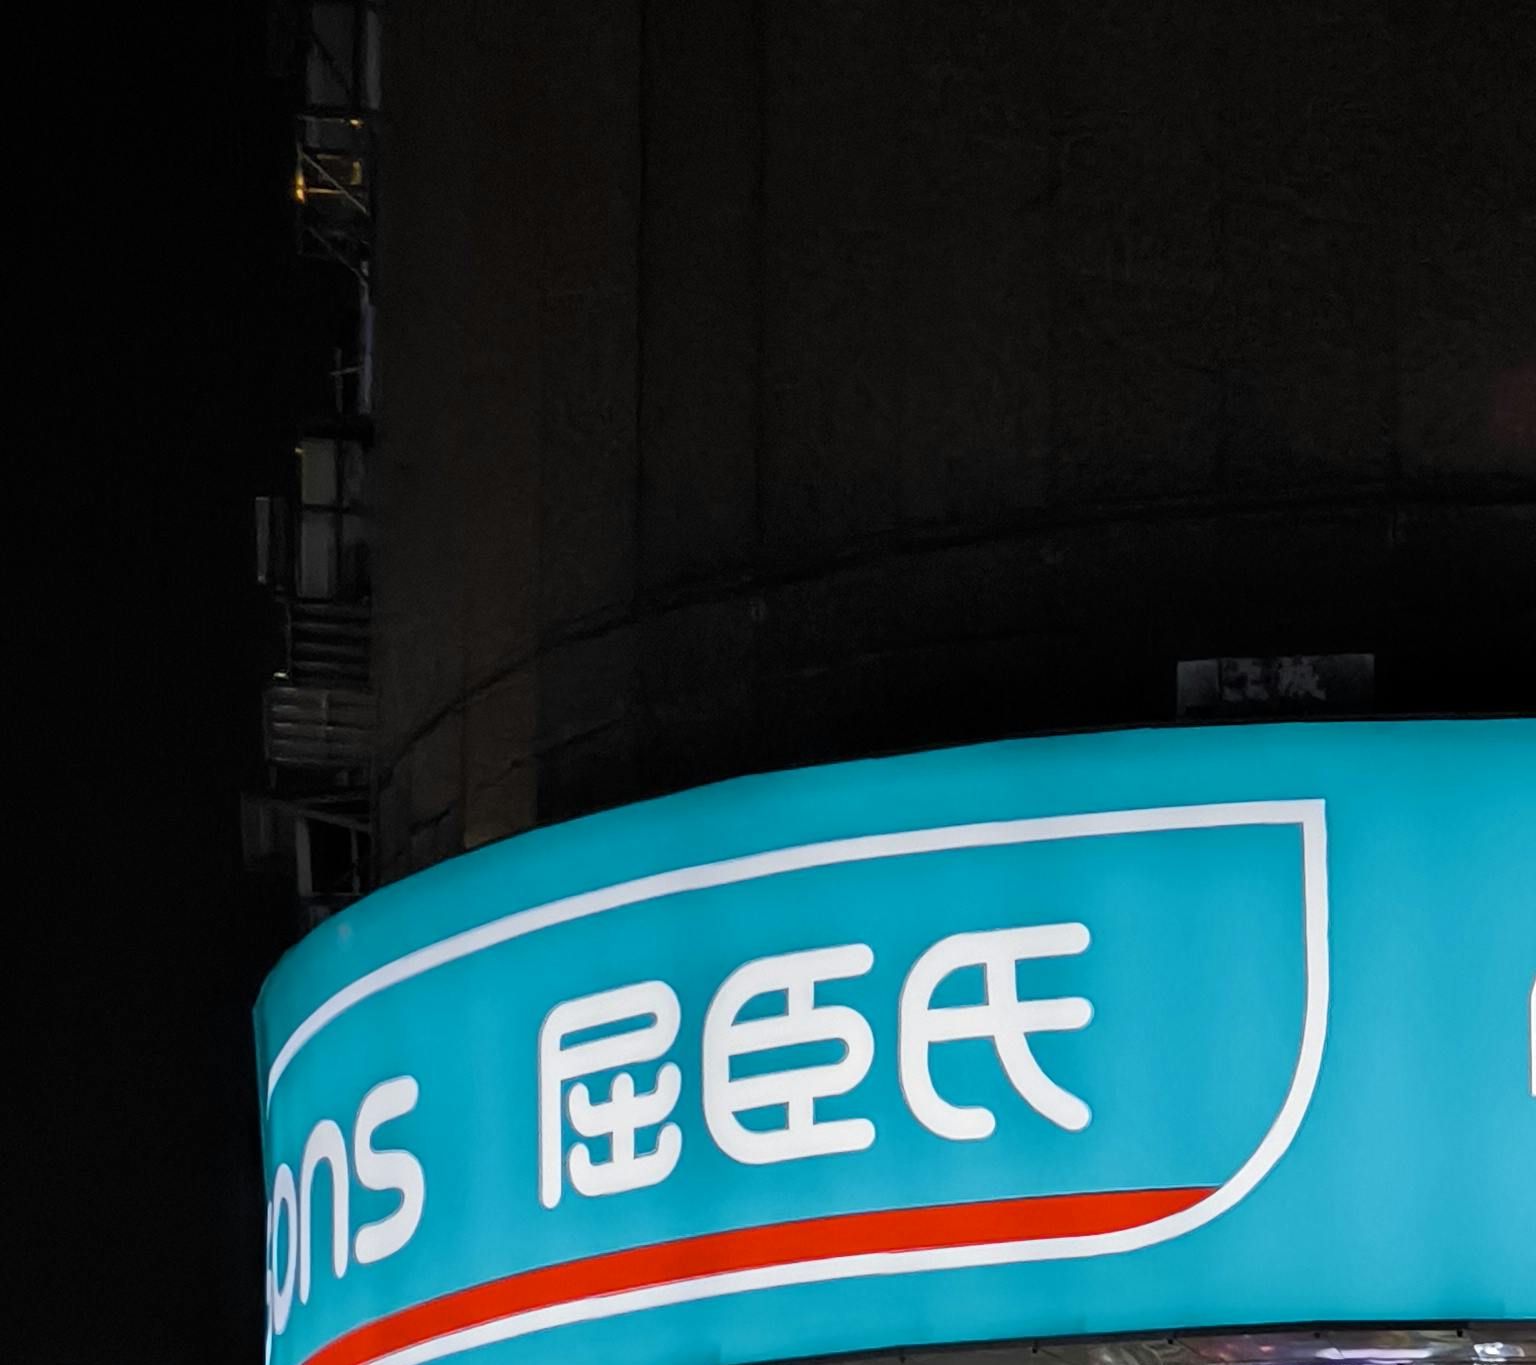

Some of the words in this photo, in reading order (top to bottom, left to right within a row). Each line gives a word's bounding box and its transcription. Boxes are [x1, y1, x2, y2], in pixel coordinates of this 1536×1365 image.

[538, 921, 1093, 1210] 屈臣氏
[266, 1074, 426, 1336] ons
